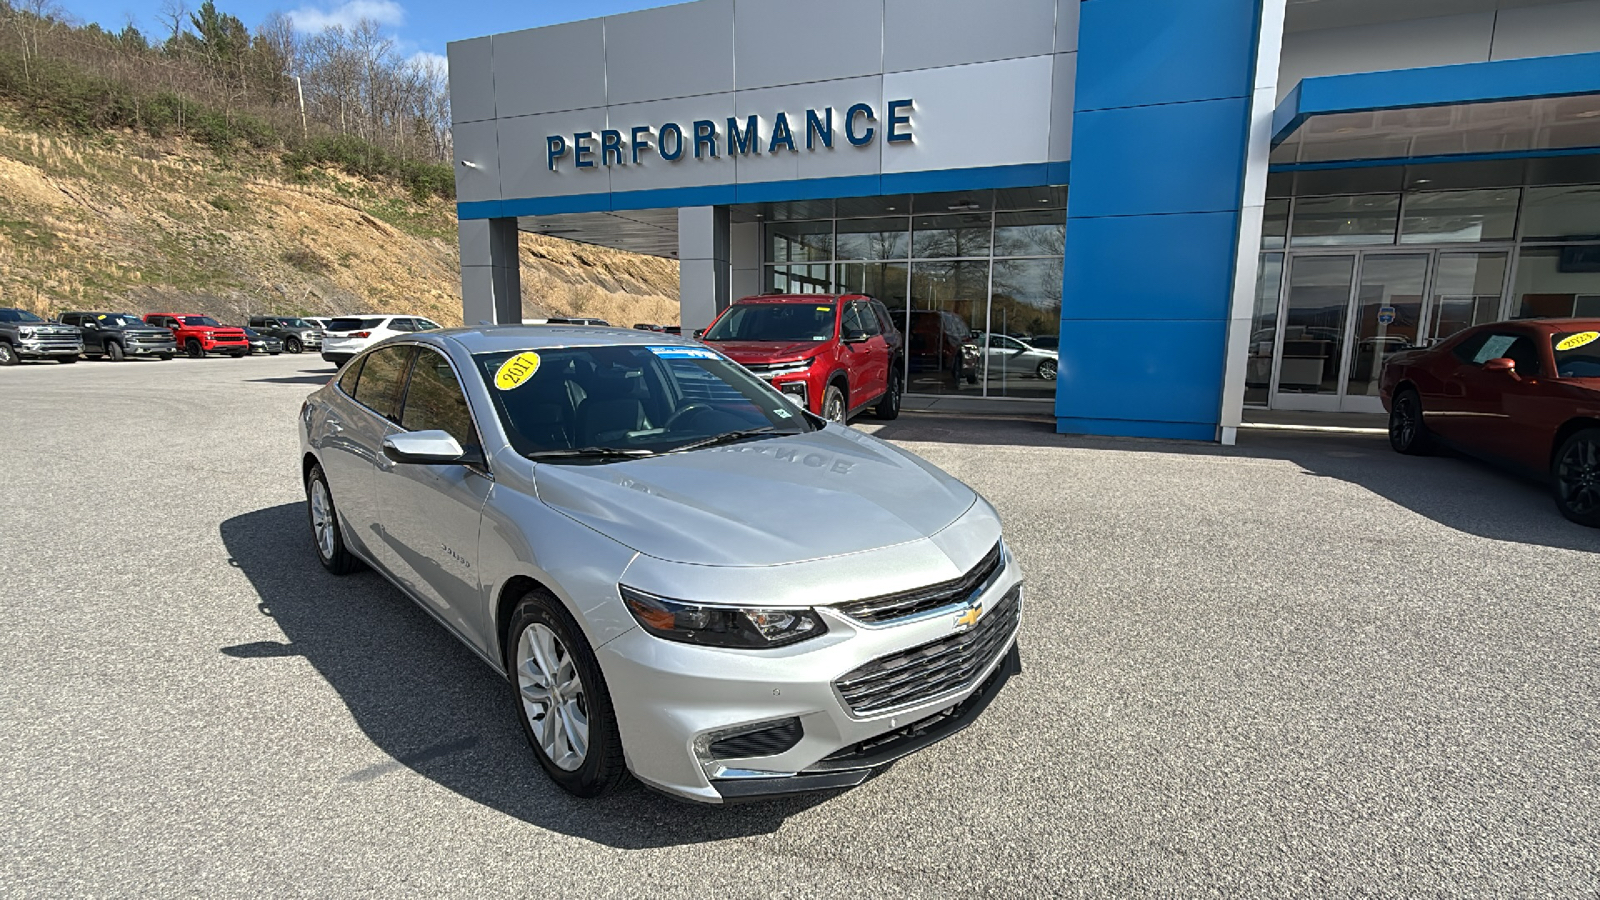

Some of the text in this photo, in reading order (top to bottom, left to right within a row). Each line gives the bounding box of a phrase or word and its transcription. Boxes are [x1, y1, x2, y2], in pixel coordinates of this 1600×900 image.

[546, 99, 914, 171] PERFORMANCE
[1563, 333, 1592, 347] 2023
[502, 356, 533, 384] 2017
